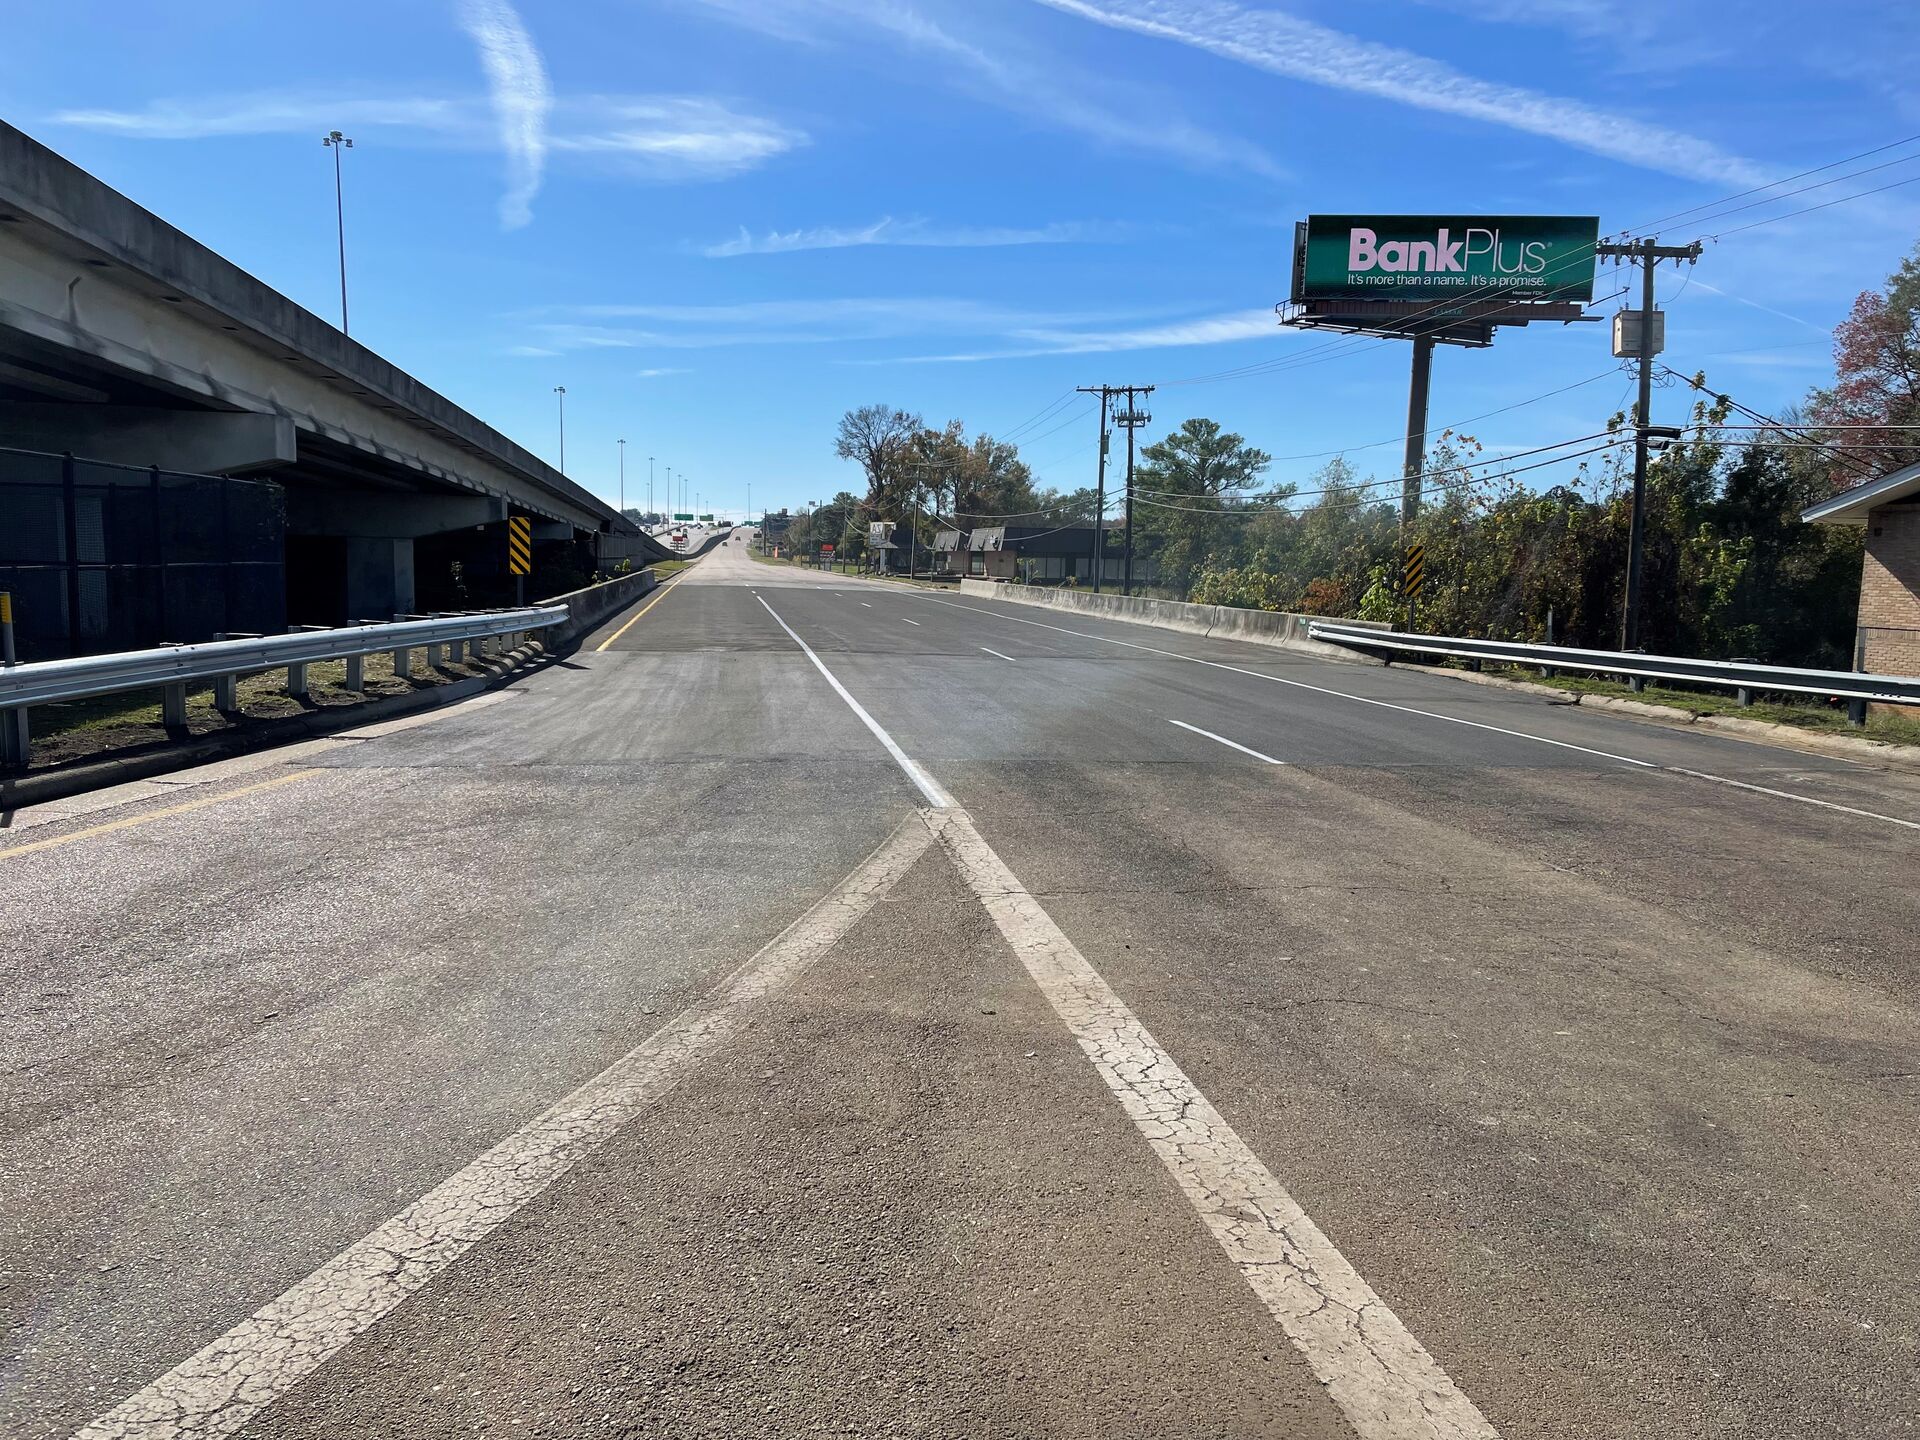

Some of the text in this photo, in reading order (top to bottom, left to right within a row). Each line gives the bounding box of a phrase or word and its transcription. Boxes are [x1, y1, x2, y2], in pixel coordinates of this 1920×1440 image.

[1348, 274, 1547, 287] It's more than a name. It's a promise.
